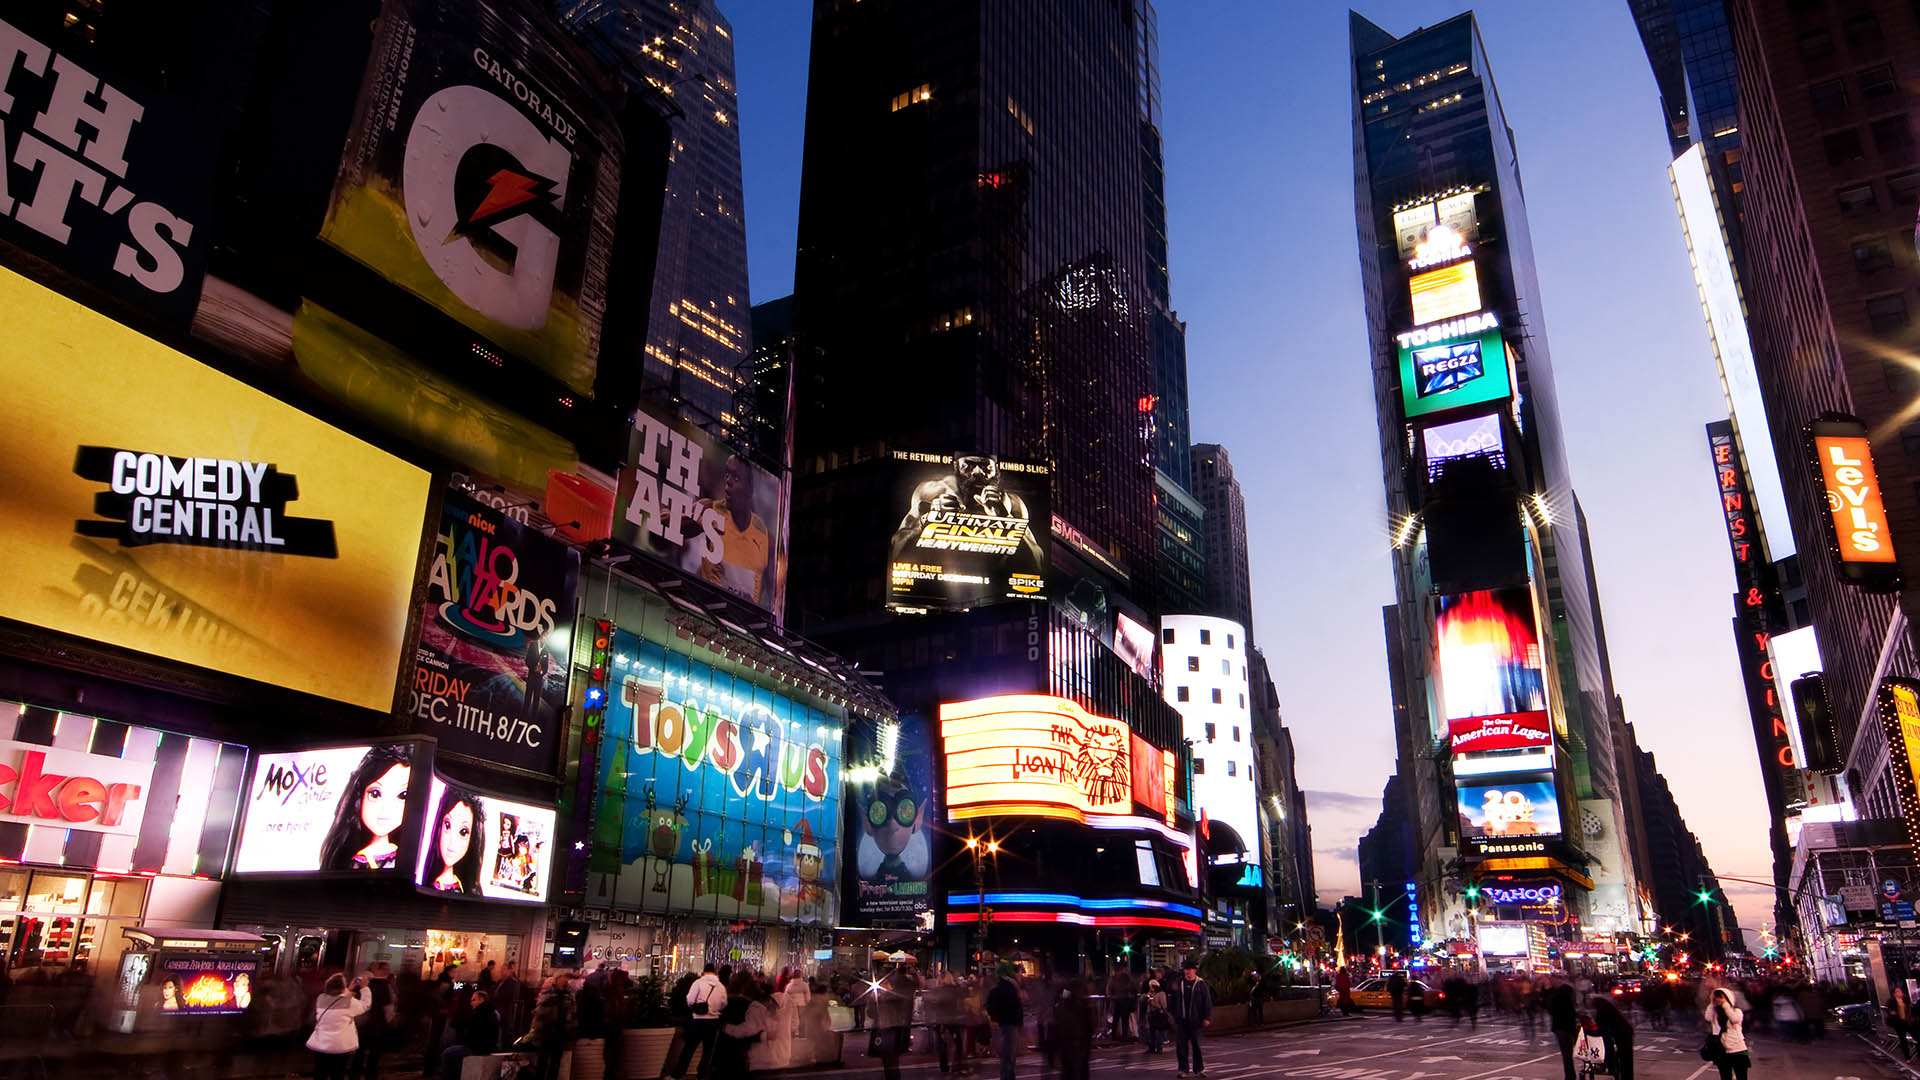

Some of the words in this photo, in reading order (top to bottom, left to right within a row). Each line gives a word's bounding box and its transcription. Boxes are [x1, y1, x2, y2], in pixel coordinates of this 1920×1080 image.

[385, 23, 417, 133] LEMON-LIME
[473, 47, 577, 145] GATORADE
[1397, 312, 1499, 349] TOSHIBA
[1422, 353, 1479, 377] REGZA
[634, 408, 703, 497] TH
[893, 451, 908, 460] THE
[909, 452, 941, 463] RETURN
[942, 455, 953, 464] OF
[111, 451, 268, 503] COMEDY
[999, 461, 1025, 472] KIMBO
[1026, 464, 1048, 474] SLICE
[131, 496, 285, 545] CENTRAL
[625, 469, 725, 565] AT'S
[928, 511, 1029, 530] ULTIMATE
[1718, 443, 1751, 561] ERNST
[1746, 587, 1763, 606] &
[920, 523, 1026, 541] FINALE
[1051, 515, 1081, 548] GMC
[437, 528, 519, 587] HALO
[915, 538, 1018, 555] HEAVYWEIGHTS
[892, 577, 914, 586] 10PM
[893, 562, 912, 571] LIVE
[912, 563, 919, 571] &
[920, 564, 942, 573] FREE
[428, 553, 557, 634] AWARDS
[1008, 578, 1044, 588] SPIKE
[413, 667, 471, 703] RIDAY
[624, 680, 738, 770] TOYS
[782, 741, 827, 797] US
[1050, 724, 1074, 746] THE
[1452, 725, 1510, 747] American
[1512, 724, 1550, 740] Lager
[1013, 748, 1057, 780] LION
[1480, 842, 1545, 853] Panasonic
[914, 902, 928, 910] abc
[1481, 885, 1561, 905] YAHOO!
